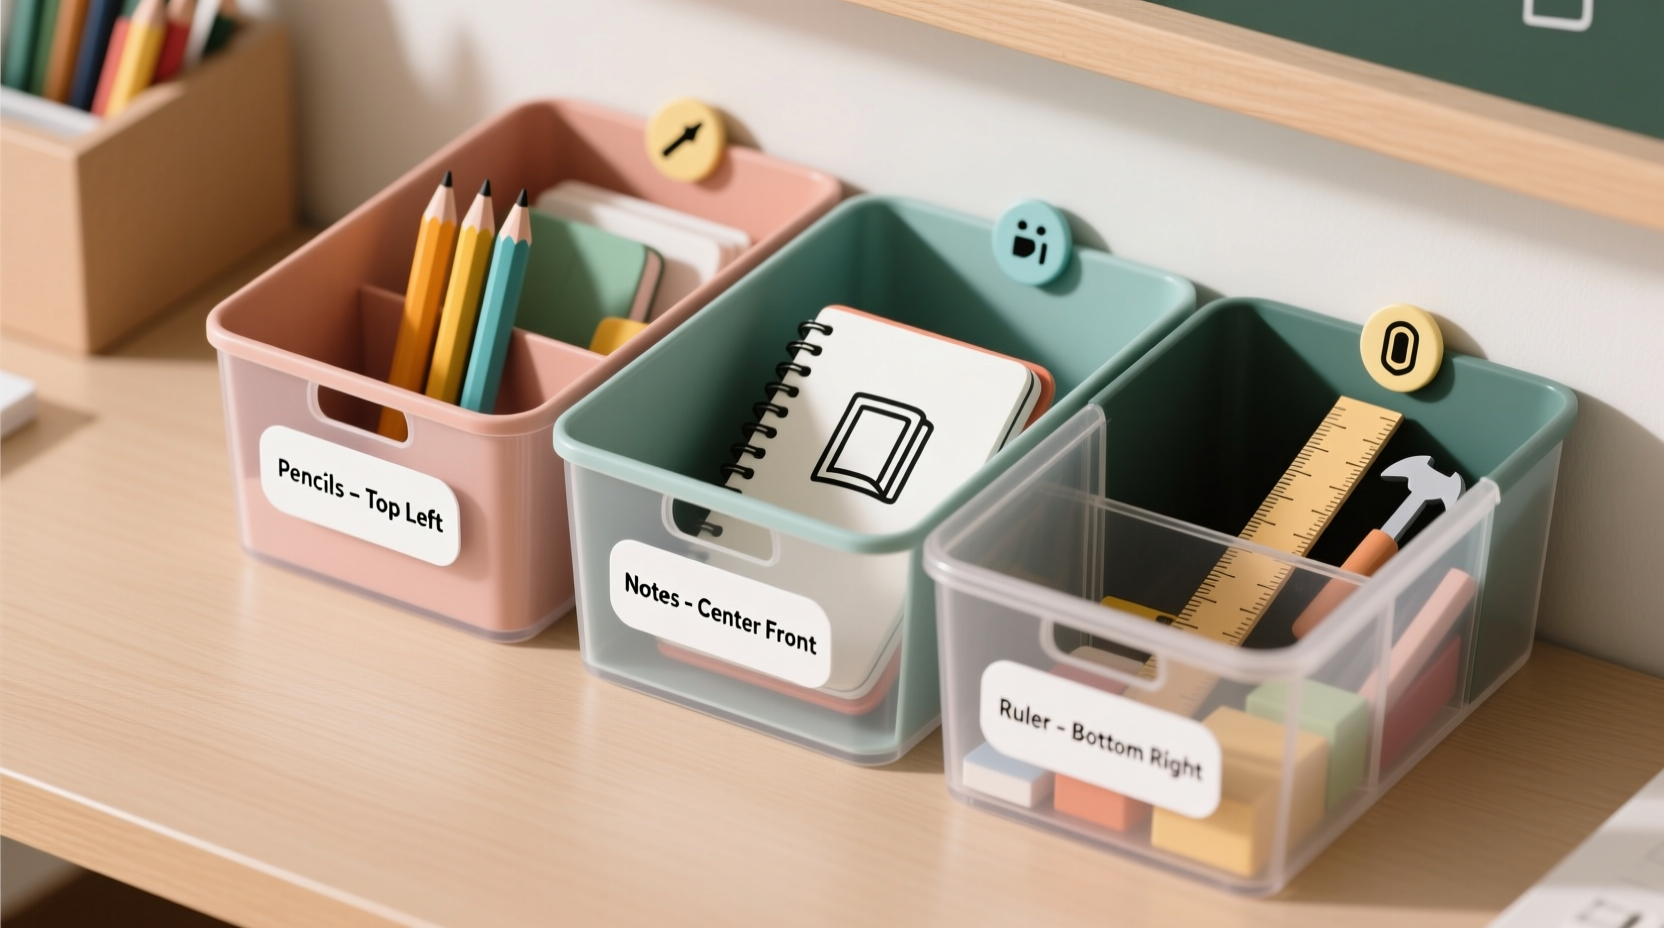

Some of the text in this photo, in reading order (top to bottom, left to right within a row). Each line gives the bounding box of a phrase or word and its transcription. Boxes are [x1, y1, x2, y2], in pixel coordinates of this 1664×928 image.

[278, 457, 345, 499] Pencils
[365, 487, 401, 521] Top
[405, 501, 444, 533] Left
[625, 571, 680, 608] Notes
[697, 597, 762, 635] Center
[765, 618, 817, 656] Front
[999, 698, 1051, 731] Ruler
[1072, 722, 1144, 761] Bottom
[1150, 747, 1203, 780] Right
